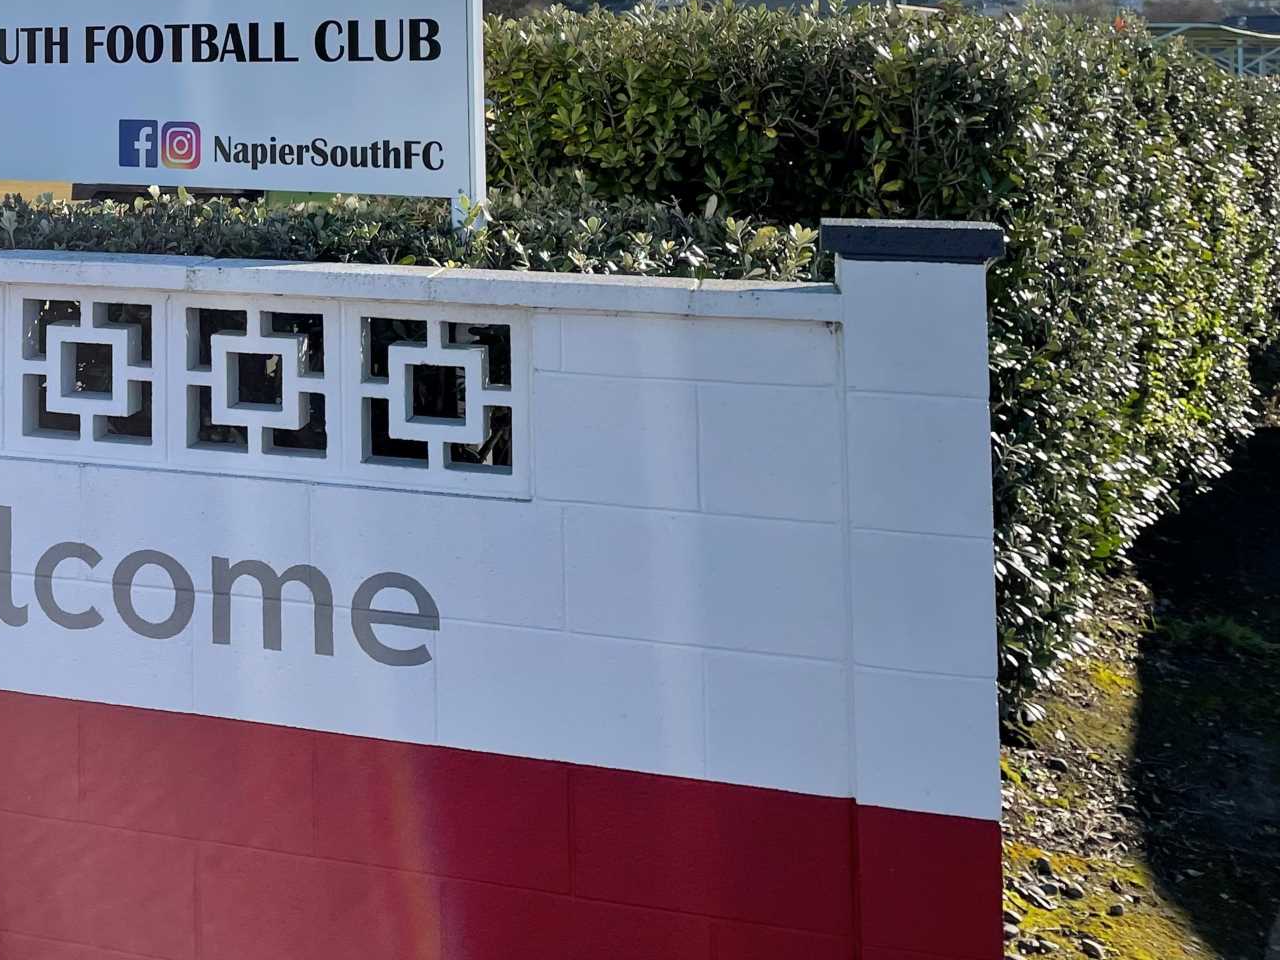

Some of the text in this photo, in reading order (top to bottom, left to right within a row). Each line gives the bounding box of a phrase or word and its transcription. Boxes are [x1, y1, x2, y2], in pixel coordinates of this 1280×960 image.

[85, 22, 299, 64] FOOTBALL
[314, 18, 442, 62] CLUB
[214, 135, 444, 171] NapierSouthFC
